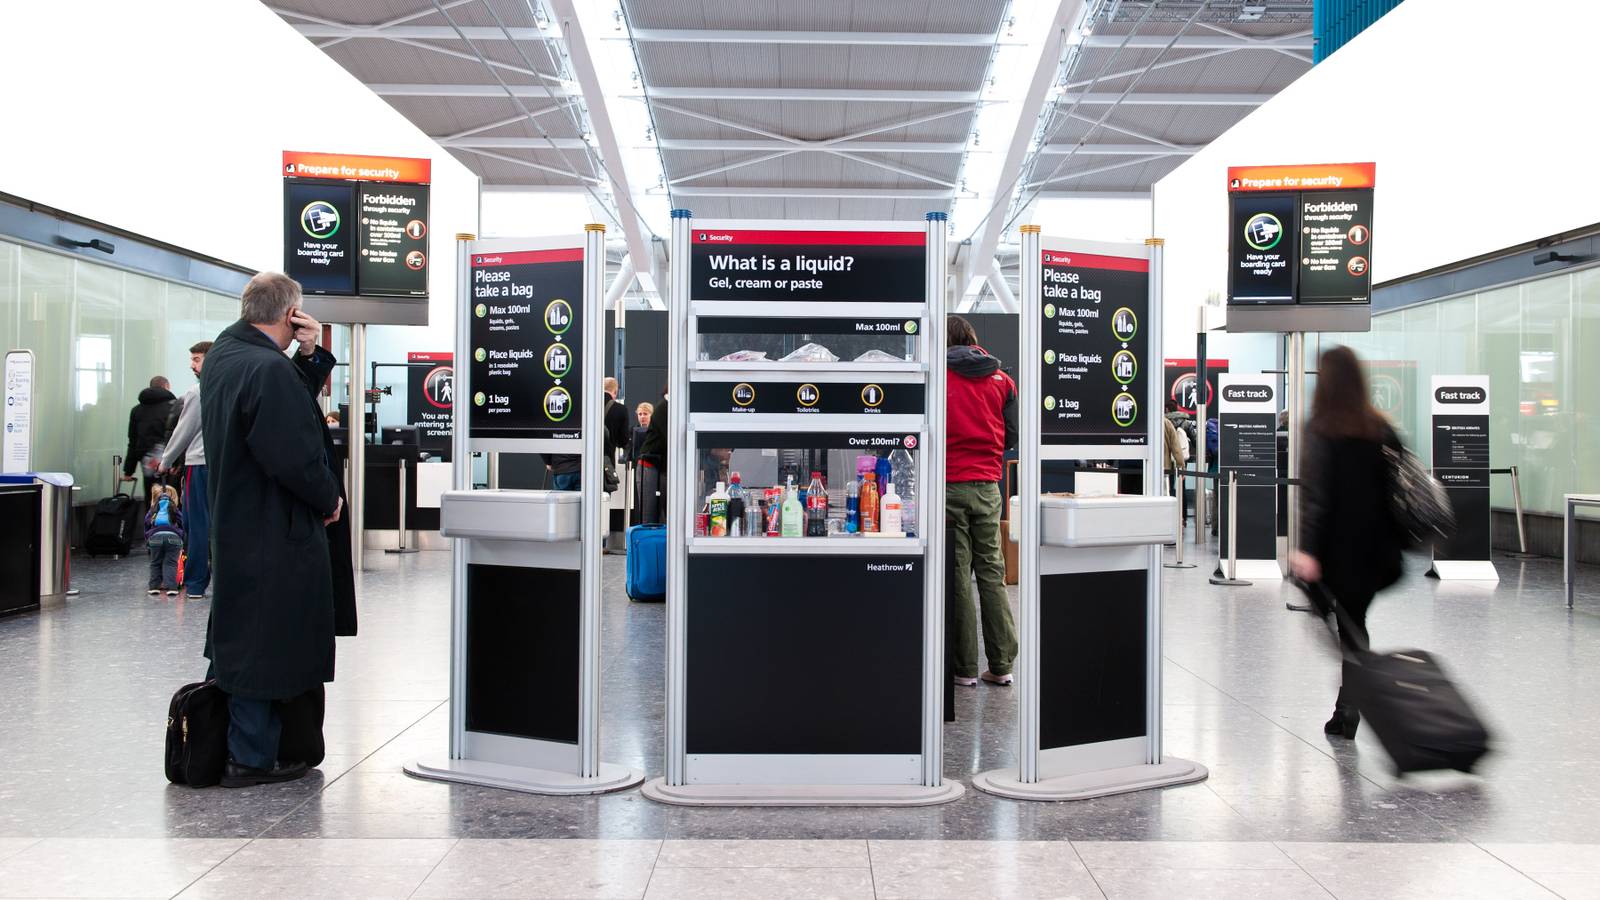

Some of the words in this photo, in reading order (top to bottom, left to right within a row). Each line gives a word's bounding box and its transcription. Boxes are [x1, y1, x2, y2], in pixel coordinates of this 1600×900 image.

[298, 164, 339, 175] Prepare
[341, 168, 357, 177] for
[359, 170, 399, 180] security
[1242, 178, 1282, 188] Prepare
[1284, 176, 1300, 186] for
[1301, 175, 1343, 187] security
[363, 194, 416, 206] Forbidden
[388, 207, 411, 215] security
[1304, 202, 1358, 212] Forbidden
[1329, 213, 1353, 221] security
[709, 234, 733, 242] Security
[322, 243, 338, 251] your
[298, 249, 328, 258] boarding
[311, 258, 331, 266] ready
[709, 255, 757, 270] What
[762, 255, 775, 270] is
[781, 258, 791, 270] a
[796, 255, 854, 274] liquid?
[1052, 256, 1071, 264] Security
[1240, 261, 1270, 270] boarding
[475, 270, 511, 283] Please
[1044, 269, 1080, 283] Please
[1253, 268, 1273, 277] ready
[709, 277, 732, 289] Gel,
[735, 279, 771, 289] cream
[774, 279, 787, 288] or
[790, 278, 823, 291] paste
[475, 284, 499, 297] take
[501, 285, 509, 296] a
[511, 283, 533, 298] bag
[1043, 285, 1069, 298] take
[1070, 287, 1078, 299] a
[1080, 286, 1102, 303] bag
[489, 306, 507, 315] Max
[507, 304, 531, 314] 100ml
[1059, 307, 1076, 317] Max
[1077, 309, 1099, 318] 100ml
[855, 322, 874, 332] Max
[875, 321, 901, 332] 100ml
[489, 350, 508, 359] Place
[508, 349, 534, 360] liquids
[1059, 353, 1078, 362] Place
[1078, 354, 1102, 364] liquids
[1247, 390, 1268, 398] track
[1460, 391, 1481, 399] track
[488, 395, 494, 404] 1
[494, 394, 510, 406] bag
[1059, 399, 1064, 408] 1
[1065, 399, 1080, 410] bag
[421, 412, 436, 420] You
[414, 421, 444, 429] entering
[849, 436, 869, 446] Over
[871, 436, 900, 446] 100ml?
[867, 563, 904, 571] Heathrow
